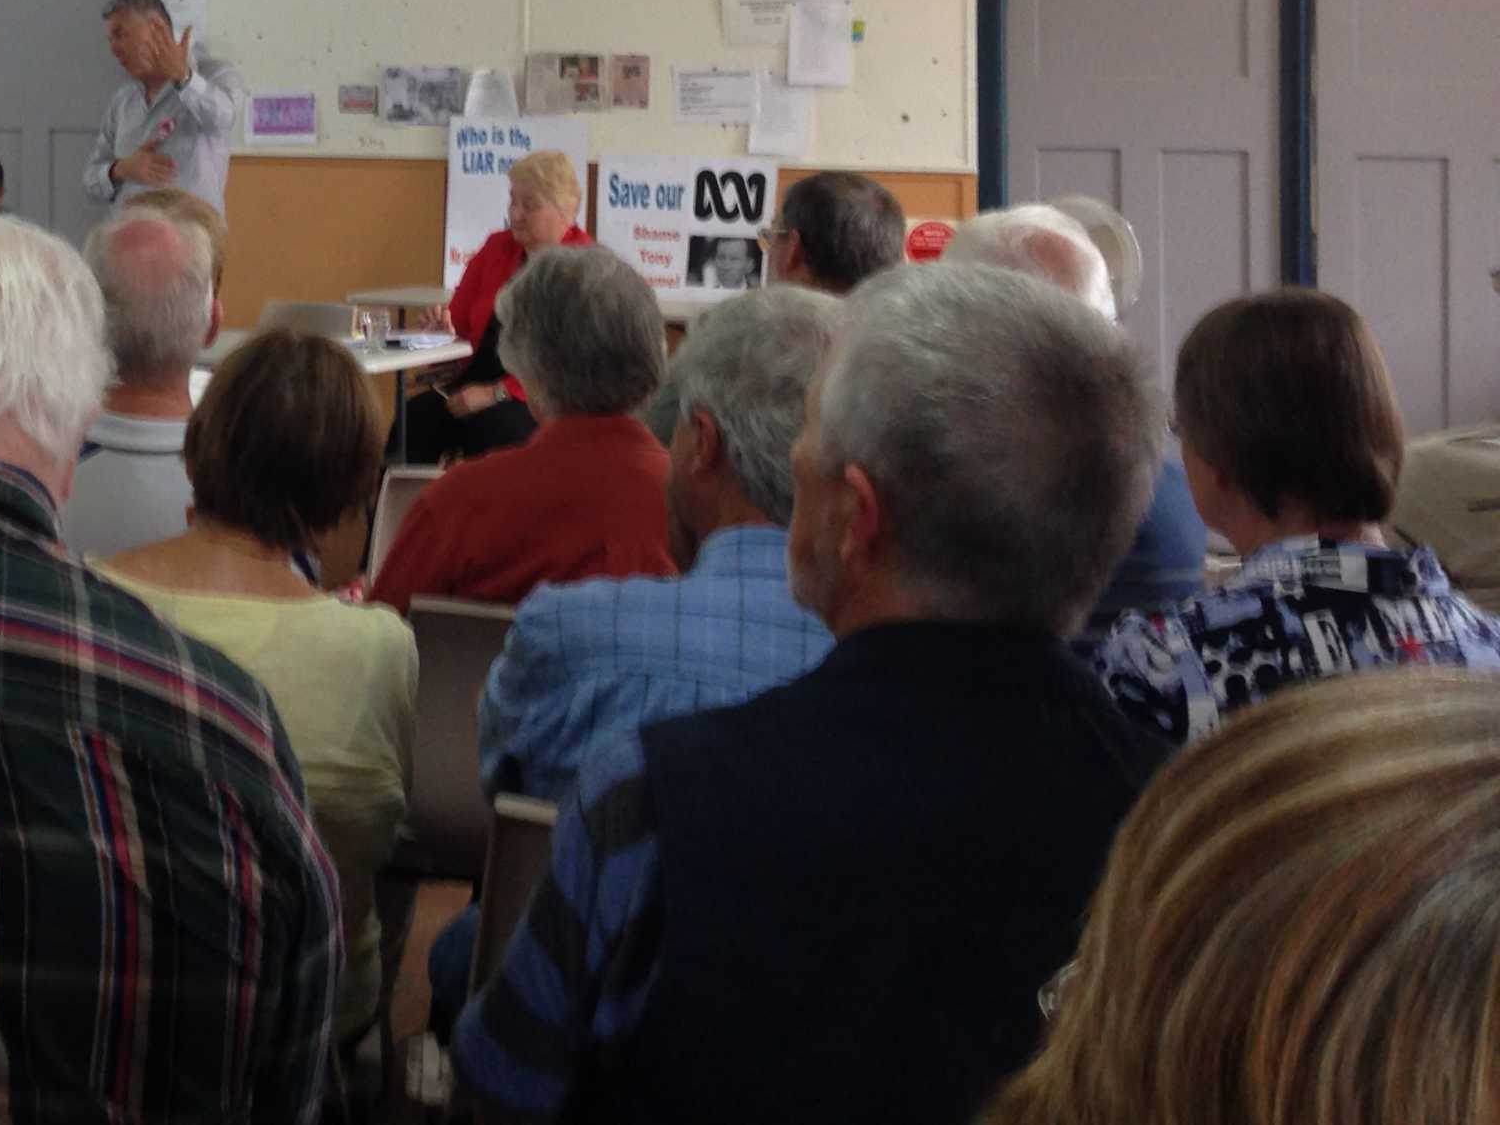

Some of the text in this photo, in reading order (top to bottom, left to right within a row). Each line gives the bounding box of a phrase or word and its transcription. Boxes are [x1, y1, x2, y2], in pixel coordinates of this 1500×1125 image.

[457, 123, 531, 152] Who is the
[462, 150, 495, 174] LIAR
[609, 173, 686, 211] Save our
[639, 249, 673, 268] Tony
